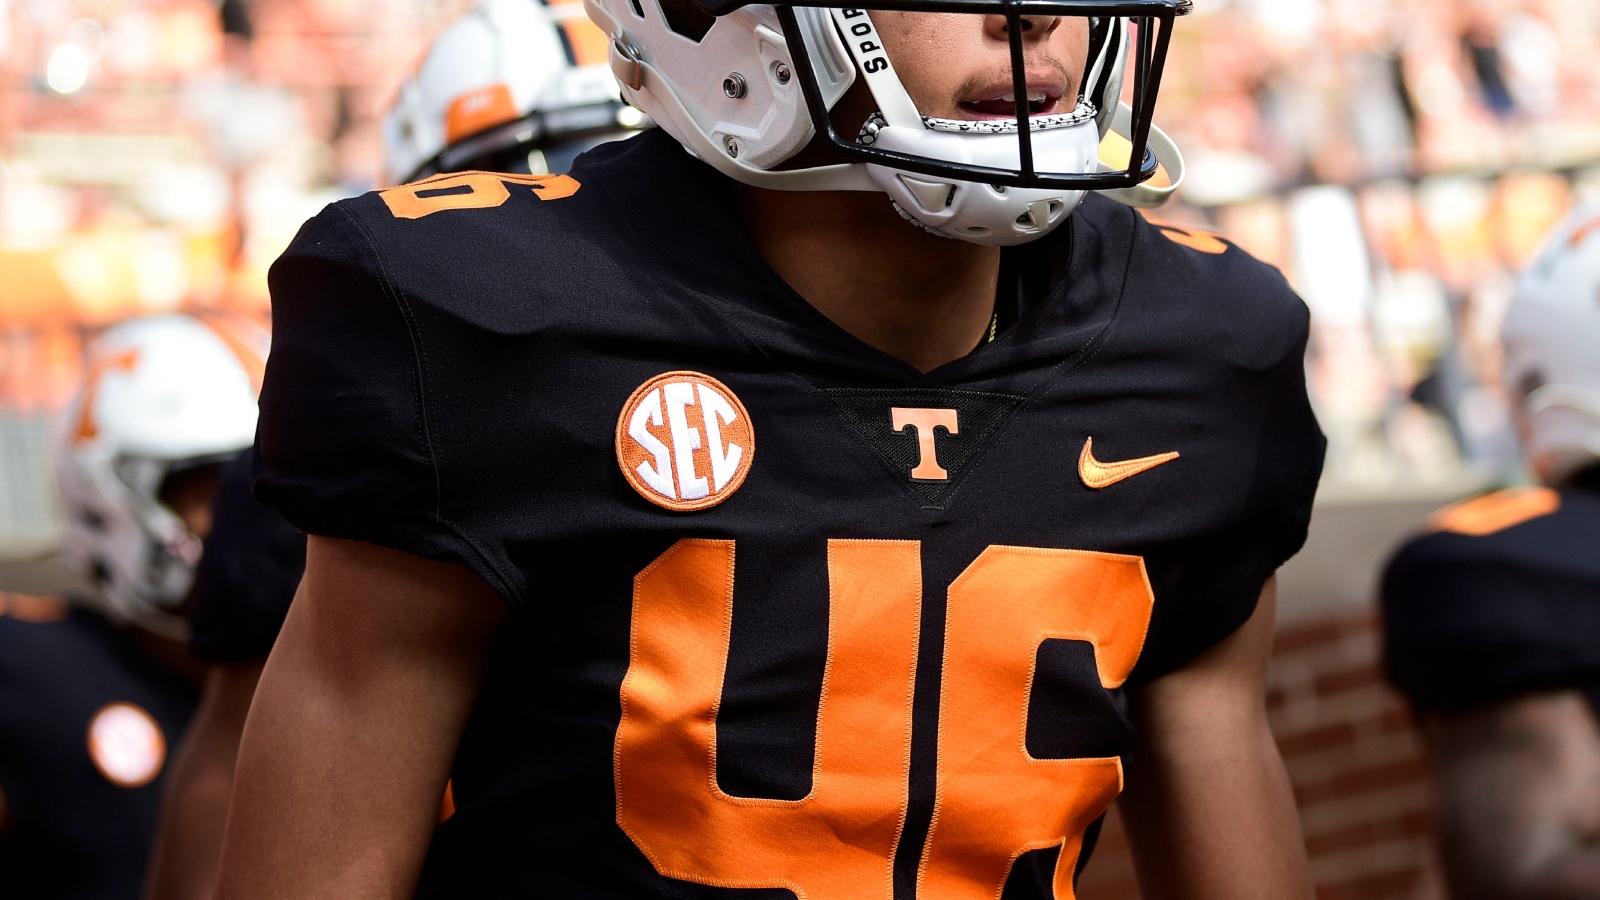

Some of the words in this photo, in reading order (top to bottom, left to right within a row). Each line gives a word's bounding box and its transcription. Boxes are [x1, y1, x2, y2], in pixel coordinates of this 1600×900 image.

[628, 382, 742, 500] SEC
[891, 407, 958, 480] T
[614, 538, 1154, 900] 46
